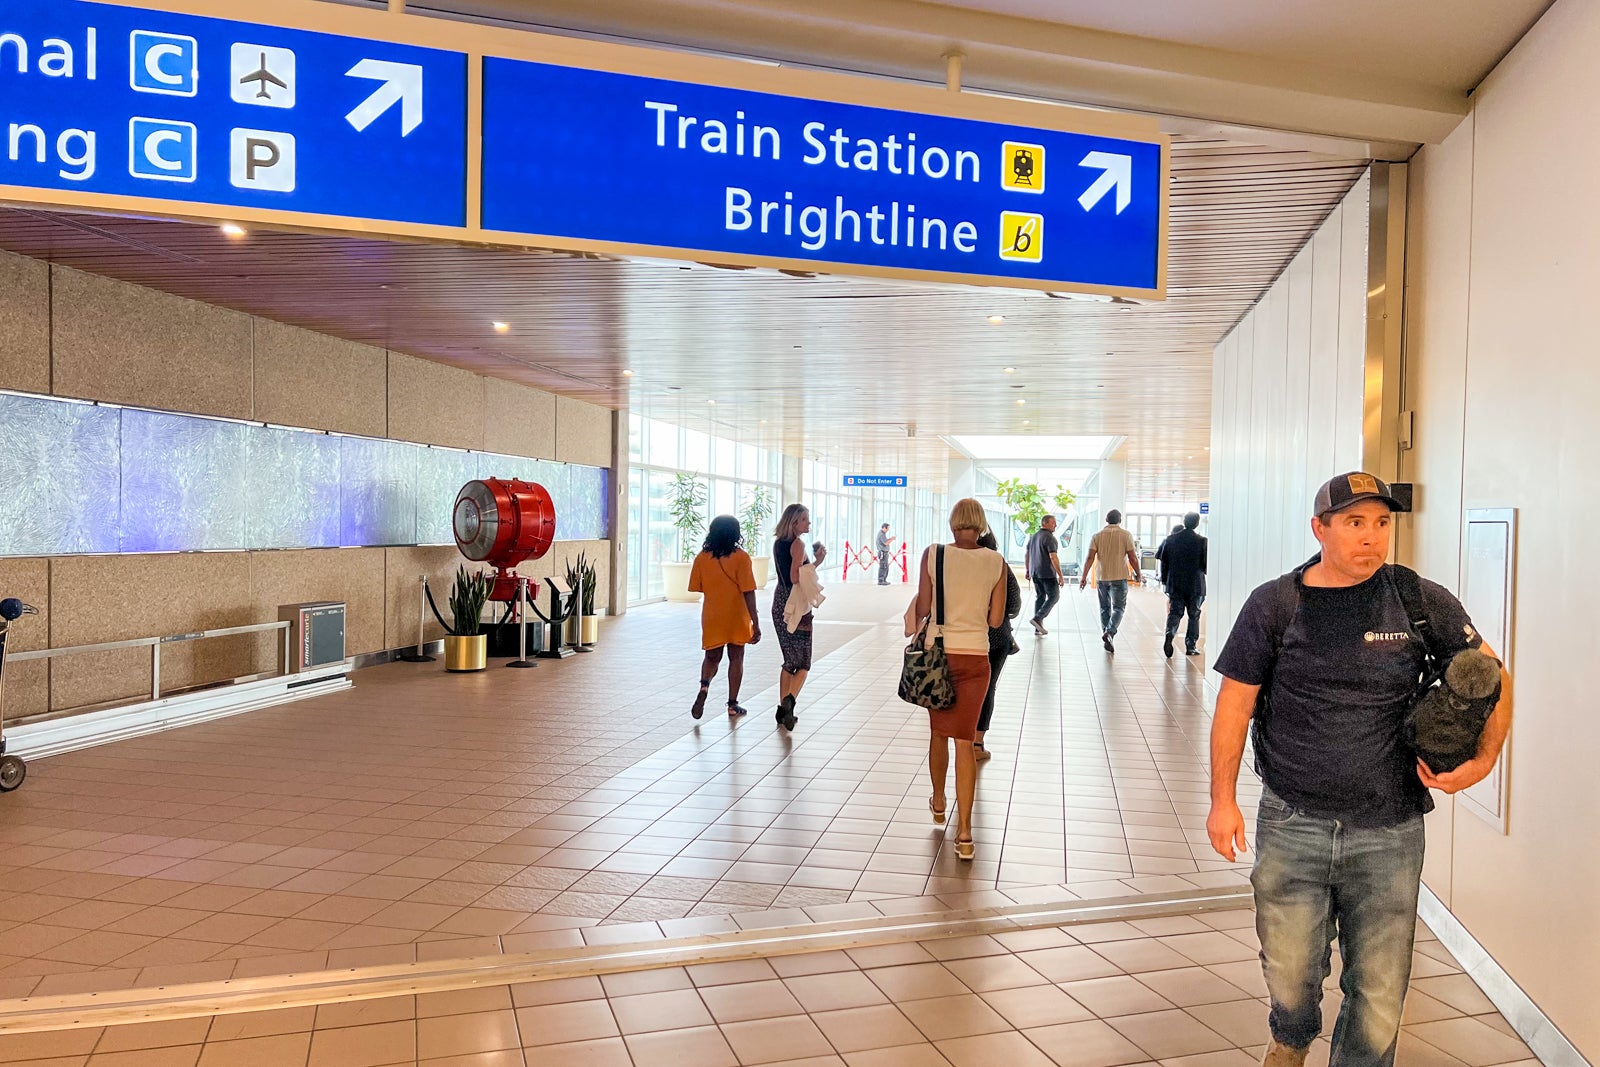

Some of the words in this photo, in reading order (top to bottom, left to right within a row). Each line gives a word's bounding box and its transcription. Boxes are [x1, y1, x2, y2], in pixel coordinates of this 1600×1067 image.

[144, 44, 184, 85] C
[8, 123, 96, 181] ng
[143, 129, 183, 171] C
[246, 137, 280, 180] P
[644, 102, 781, 160] Train
[803, 122, 979, 182] Station
[725, 187, 978, 251] Brightline
[1375, 632, 1409, 640] BERETTA
